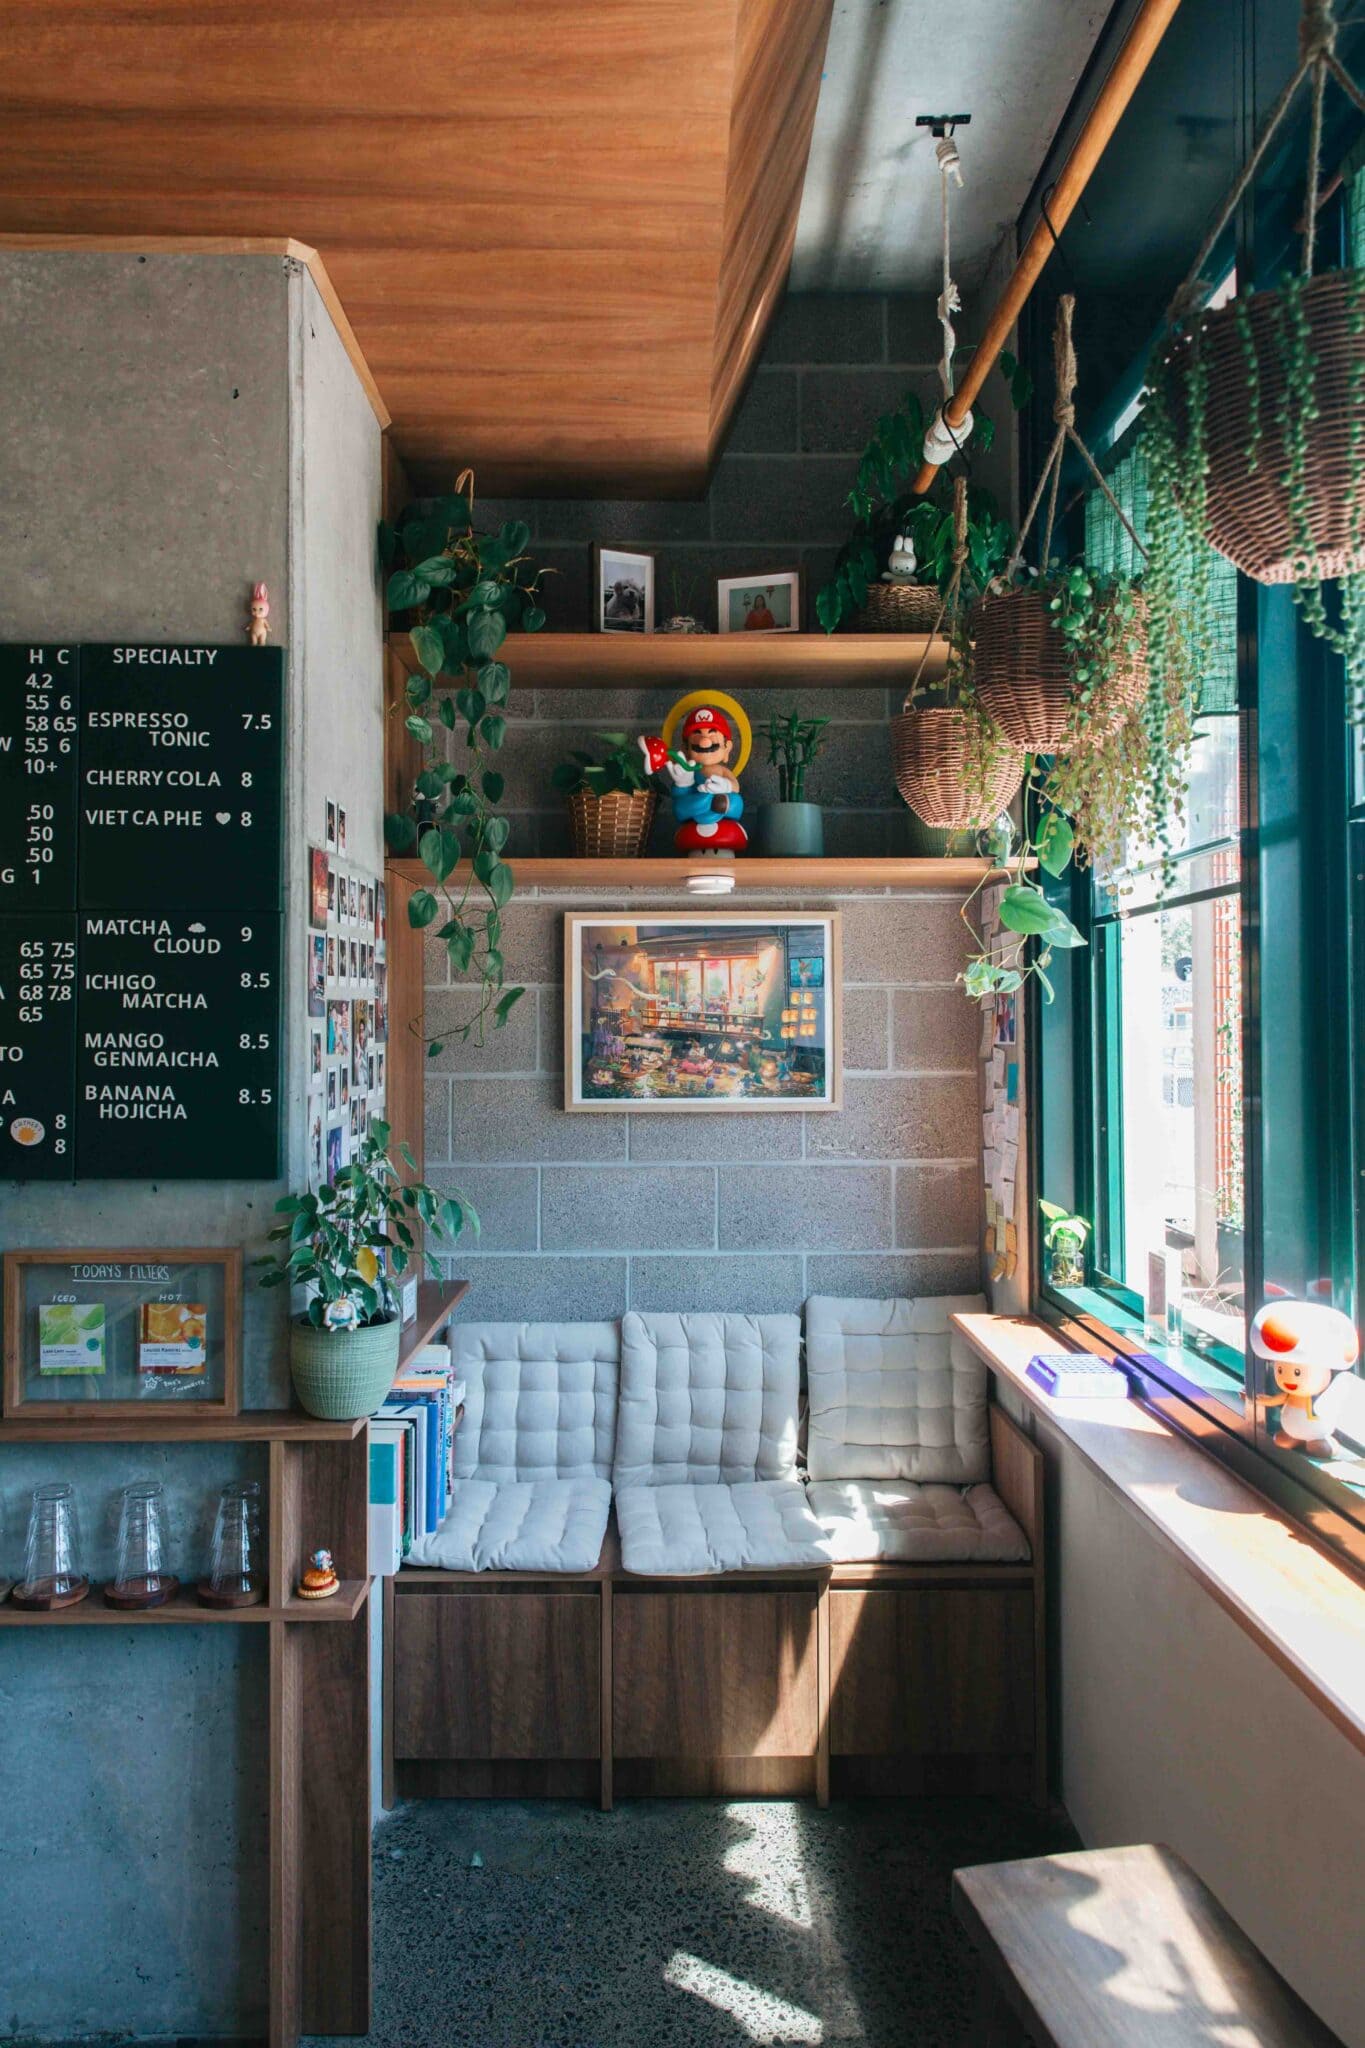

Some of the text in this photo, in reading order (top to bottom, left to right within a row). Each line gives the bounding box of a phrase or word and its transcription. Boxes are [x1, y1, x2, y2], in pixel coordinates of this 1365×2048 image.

[30, 649, 69, 664] H C
[114, 648, 217, 664] SPECIALTY
[26, 674, 52, 689] 4.2
[26, 695, 71, 710] 5.5 6
[26, 716, 76, 732] 5.8 6.5
[89, 712, 271, 729] ESPRESSO 7.5
[26, 738, 48, 753] 5.5
[60, 738, 70, 753] 6
[149, 731, 210, 746] TONIC
[25, 759, 57, 773] 10+
[87, 770, 252, 787] CHERRY COLA 8
[27, 805, 53, 820] .50
[86, 810, 251, 826] VIET CA PHE 8
[27, 826, 53, 842] .50
[26, 848, 53, 863] .50
[32, 869, 39, 884] 1
[87, 920, 171, 935] MATCHA
[241, 927, 252, 941] 9
[21, 942, 75, 958] 6.5 7.5
[154, 938, 220, 953] CLOUD
[20, 964, 74, 979] 6.5 7.5
[86, 973, 269, 989] ICHIGO 8.5
[20, 985, 43, 1001] 6.8
[48, 986, 71, 1001] 7.8
[123, 993, 207, 1008] MATCHA
[19, 1007, 42, 1022] 6.5
[86, 1033, 269, 1049] MANGO 8.5
[95, 1052, 218, 1067] GENMAICHA
[86, 1085, 271, 1104] BANANA 8.5
[100, 1104, 187, 1119] HOJICHA
[56, 1114, 66, 1129] 8
[55, 1139, 65, 1153] 8
[130, 1265, 169, 1280] FILTERS
[52, 1295, 77, 1303] ICED
[159, 1294, 182, 1302] HOT
